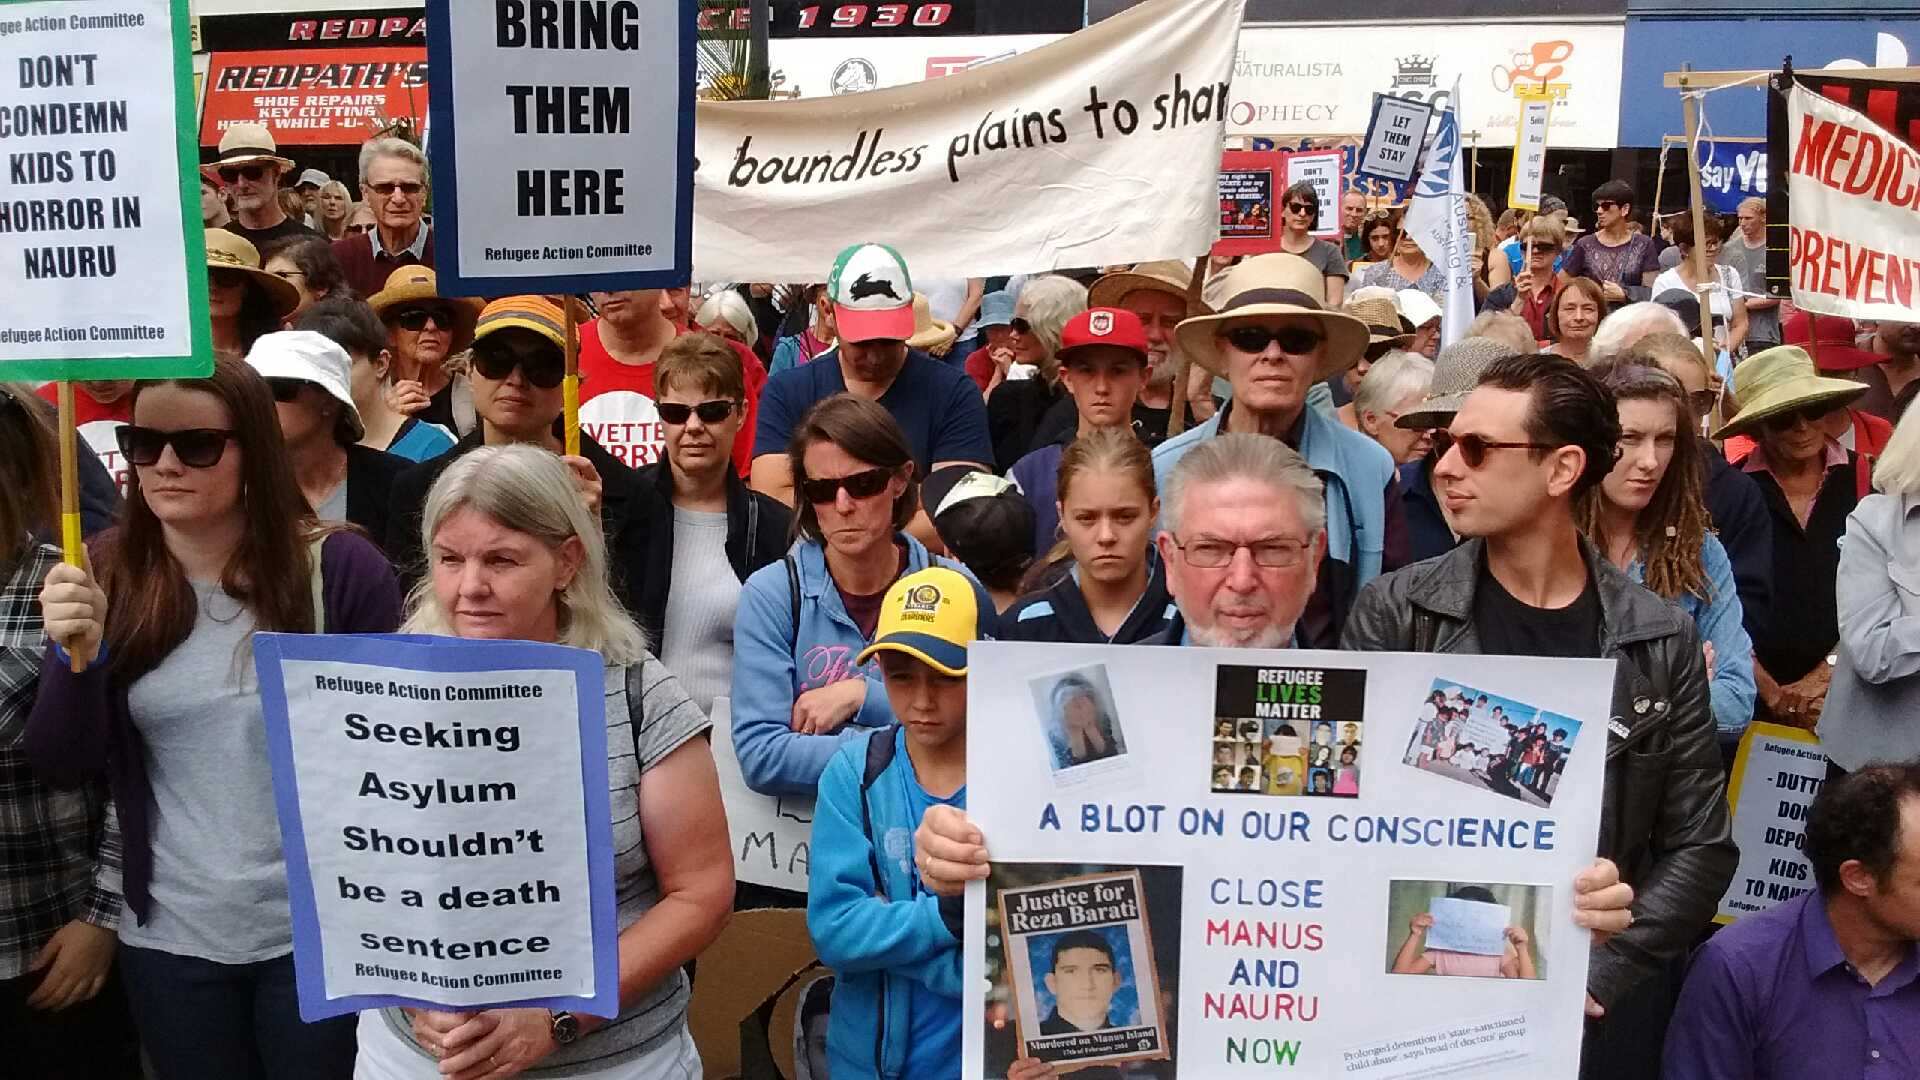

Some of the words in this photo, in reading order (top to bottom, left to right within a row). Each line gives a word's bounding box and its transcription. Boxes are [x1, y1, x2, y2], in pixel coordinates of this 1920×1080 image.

[25, 16, 66, 32] Action
[70, 13, 145, 30] Committee
[496, 0, 639, 50] BRING
[798, 3, 952, 29] 1930
[19, 54, 98, 88] DON'T
[215, 61, 428, 92] REDPATH'S
[1233, 63, 1343, 77] NATURALISTA
[253, 95, 299, 107] SHOE
[305, 94, 386, 106] REPAIRS
[259, 107, 294, 118] KEY
[299, 106, 376, 117] CUTTING
[506, 85, 630, 134] THEM
[0, 100, 128, 138] CONDEMN
[275, 118, 334, 129] WHILE
[1392, 114, 1412, 129] LET
[728, 128, 928, 187] boundless
[947, 108, 1068, 182] plains
[1084, 86, 1139, 139] to
[1383, 130, 1412, 147] THEM
[10, 150, 74, 184] KIDS
[80, 149, 117, 182] TO
[1378, 147, 1407, 163] STAY
[517, 169, 625, 216] HERE
[1702, 164, 1734, 194] say
[0, 198, 105, 233] HORROR
[112, 196, 142, 229] IN
[24, 245, 117, 280] NAURU
[485, 247, 540, 261] Refugee
[542, 246, 583, 260] Action
[586, 243, 652, 258] Committee
[0, 327, 42, 344] efugee
[44, 327, 87, 342] Action
[90, 325, 165, 341] Committee
[581, 422, 664, 442] VETTE
[315, 675, 384, 696] Refugee
[388, 681, 440, 701] Action
[445, 684, 543, 701] Committee
[1257, 669, 1323, 686] REFUGEE
[1256, 684, 1322, 704] LIVES
[1255, 703, 1321, 719] MATTER
[344, 712, 520, 752] Seeking
[1764, 742, 1796, 757] Refugee
[1796, 749, 1822, 763] Action
[358, 771, 516, 809] Asylum
[1038, 803, 1061, 831] A
[1081, 803, 1166, 834] BLOT
[1179, 807, 1224, 836] ON
[1241, 810, 1311, 842] OUR
[1327, 814, 1556, 850] CONSCIENCE
[343, 826, 544, 858] Shouldn’t
[1769, 858, 1808, 881] KIDS
[338, 876, 386, 902] be
[400, 887, 423, 908] a
[438, 880, 561, 909] death
[1016, 888, 1089, 914] Justice
[1093, 883, 1125, 903] for
[1210, 877, 1323, 908] CLOSE
[1746, 879, 1765, 897] TO
[1010, 912, 1064, 932] Reza
[1070, 900, 1137, 926] Barati
[360, 933, 551, 960] sentence
[1206, 919, 1323, 951] MANUS
[355, 963, 417, 982] Refugee
[421, 972, 470, 989] Action
[474, 967, 563, 988] Committee
[1228, 958, 1299, 989] AND
[1204, 992, 1318, 1021] NAURU
[1030, 1037, 1077, 1051] Murdered
[1126, 1029, 1155, 1040] Island
[1343, 1043, 1390, 1061] Prolonged
[1392, 1034, 1437, 1051] detention
[1498, 1027, 1526, 1042] group
[1226, 1036, 1301, 1066] NOW
